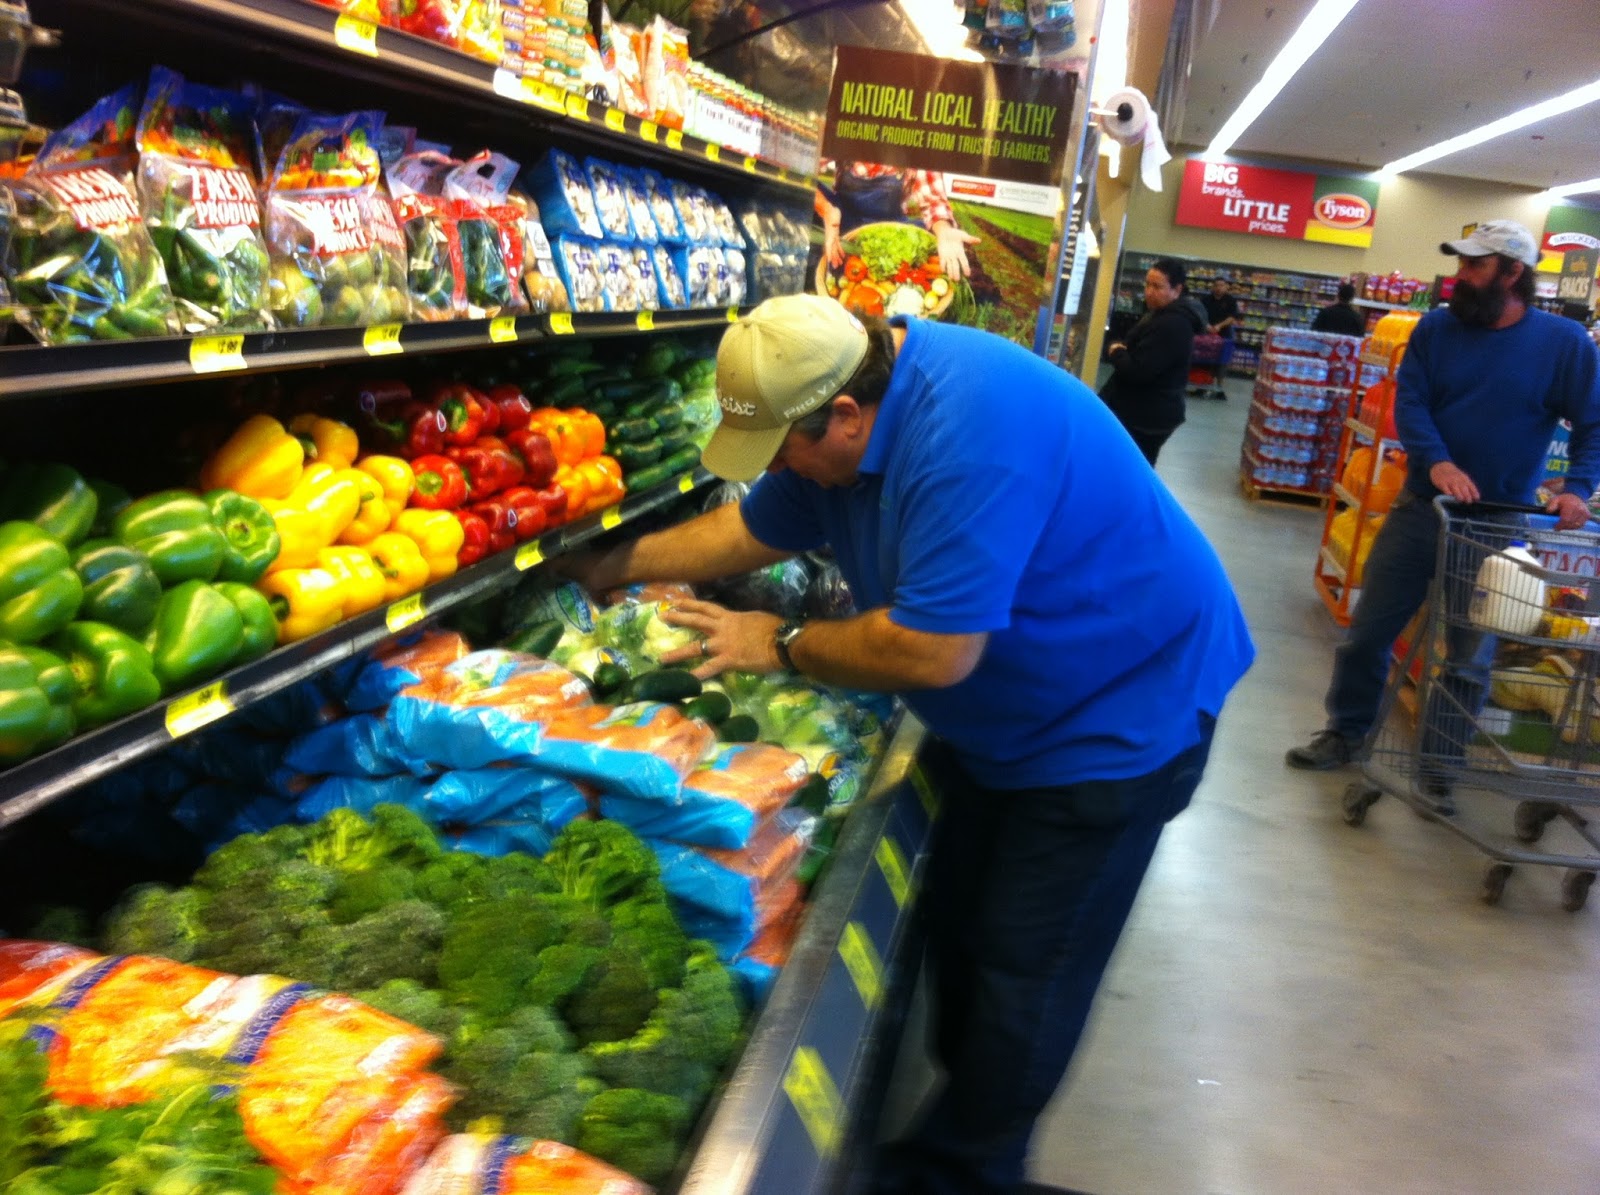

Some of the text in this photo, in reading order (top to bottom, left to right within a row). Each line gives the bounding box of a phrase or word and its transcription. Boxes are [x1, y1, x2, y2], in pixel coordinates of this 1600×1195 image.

[840, 81, 918, 121] NATURAL.
[922, 92, 977, 128] LOCAL.
[836, 120, 1052, 164] ORGANIC PRODUCE FROM TRUSTED FARMERS.
[1204, 163, 1239, 185] BIG
[1202, 182, 1245, 198] brands.
[1223, 198, 1291, 222] LITTLE
[1323, 199, 1367, 219] Tyson
[1248, 219, 1287, 234] prices.
